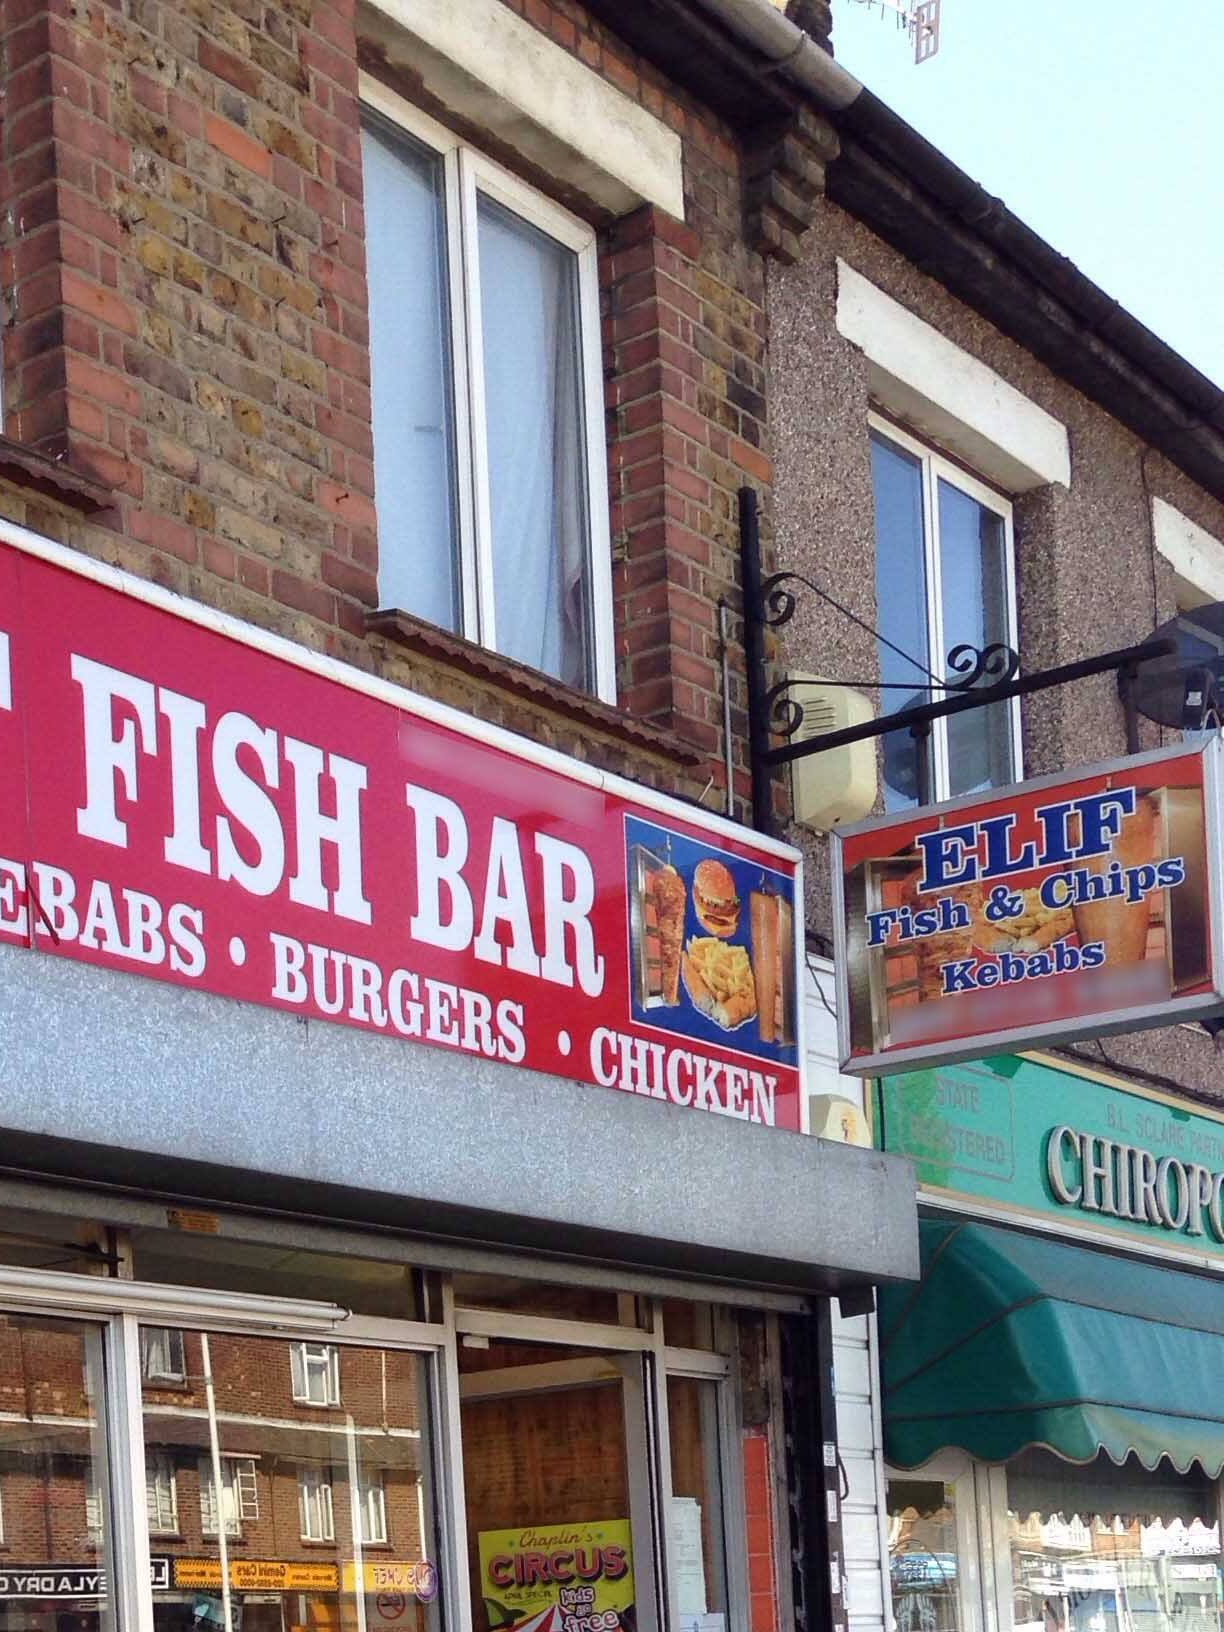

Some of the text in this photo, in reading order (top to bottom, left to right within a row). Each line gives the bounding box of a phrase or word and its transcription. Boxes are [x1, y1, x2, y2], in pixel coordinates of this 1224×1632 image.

[71, 653, 373, 925] FISH
[406, 783, 605, 998] BAR
[915, 787, 1136, 893] ELIF
[866, 857, 1185, 947] Fish & Chips
[941, 940, 1106, 996] Kebabs
[270, 933, 525, 1063] BURGERS
[590, 1028, 776, 1127] CHICKEN
[488, 1543, 629, 1587] CIRCUS
[520, 1526, 594, 1550] Chaplin's
[560, 1586, 595, 1606] kids
